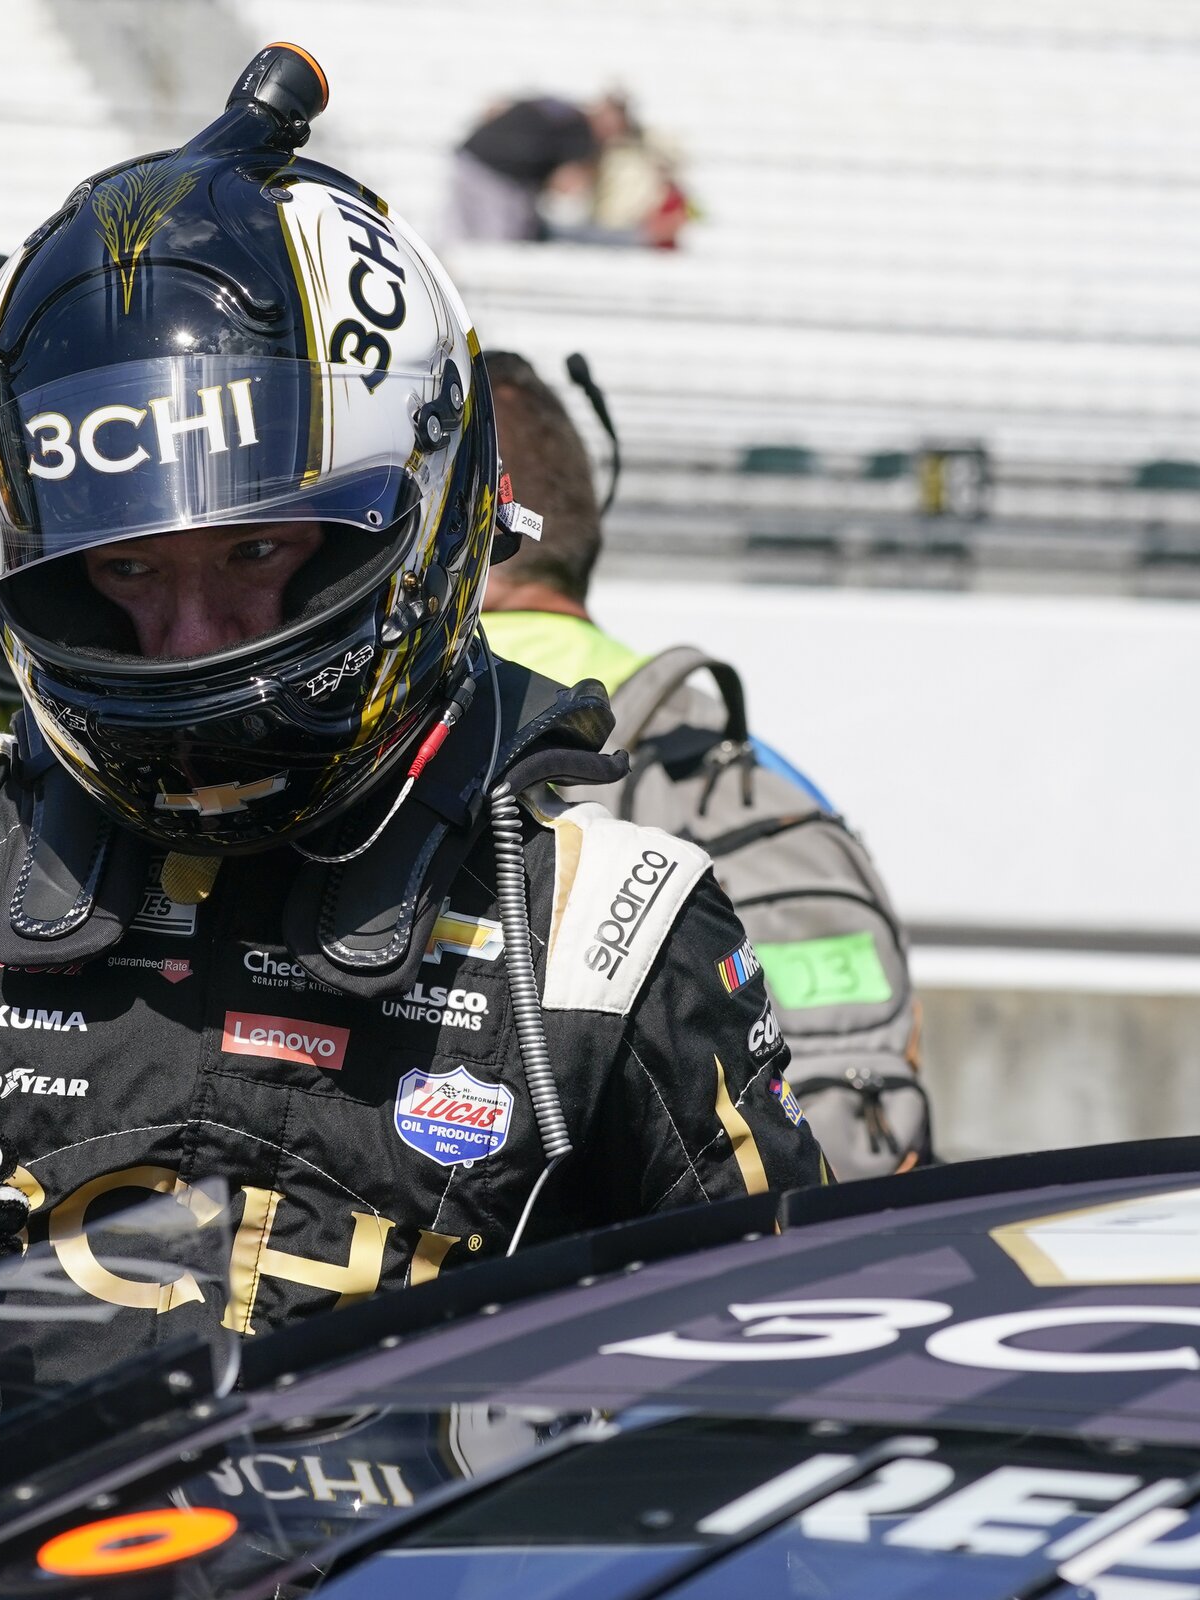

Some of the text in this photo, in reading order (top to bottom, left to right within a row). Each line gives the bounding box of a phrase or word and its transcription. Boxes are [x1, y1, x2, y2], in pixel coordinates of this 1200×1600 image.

[328, 192, 406, 395] 3CHI
[24, 378, 260, 481] 3CHI
[521, 516, 541, 531] 2022
[585, 850, 670, 974] sparco
[107, 956, 188, 972] guaranteed Rate
[251, 975, 289, 987] SCRATCH
[381, 1000, 482, 1031] UNIFORMS
[233, 1021, 336, 1057] Lenovo
[409, 1095, 504, 1128] LUCAS
[462, 1094, 508, 1107] PERFORMANCE
[401, 1119, 499, 1147] OIL PRODUCTS
[435, 1141, 461, 1155] INC.
